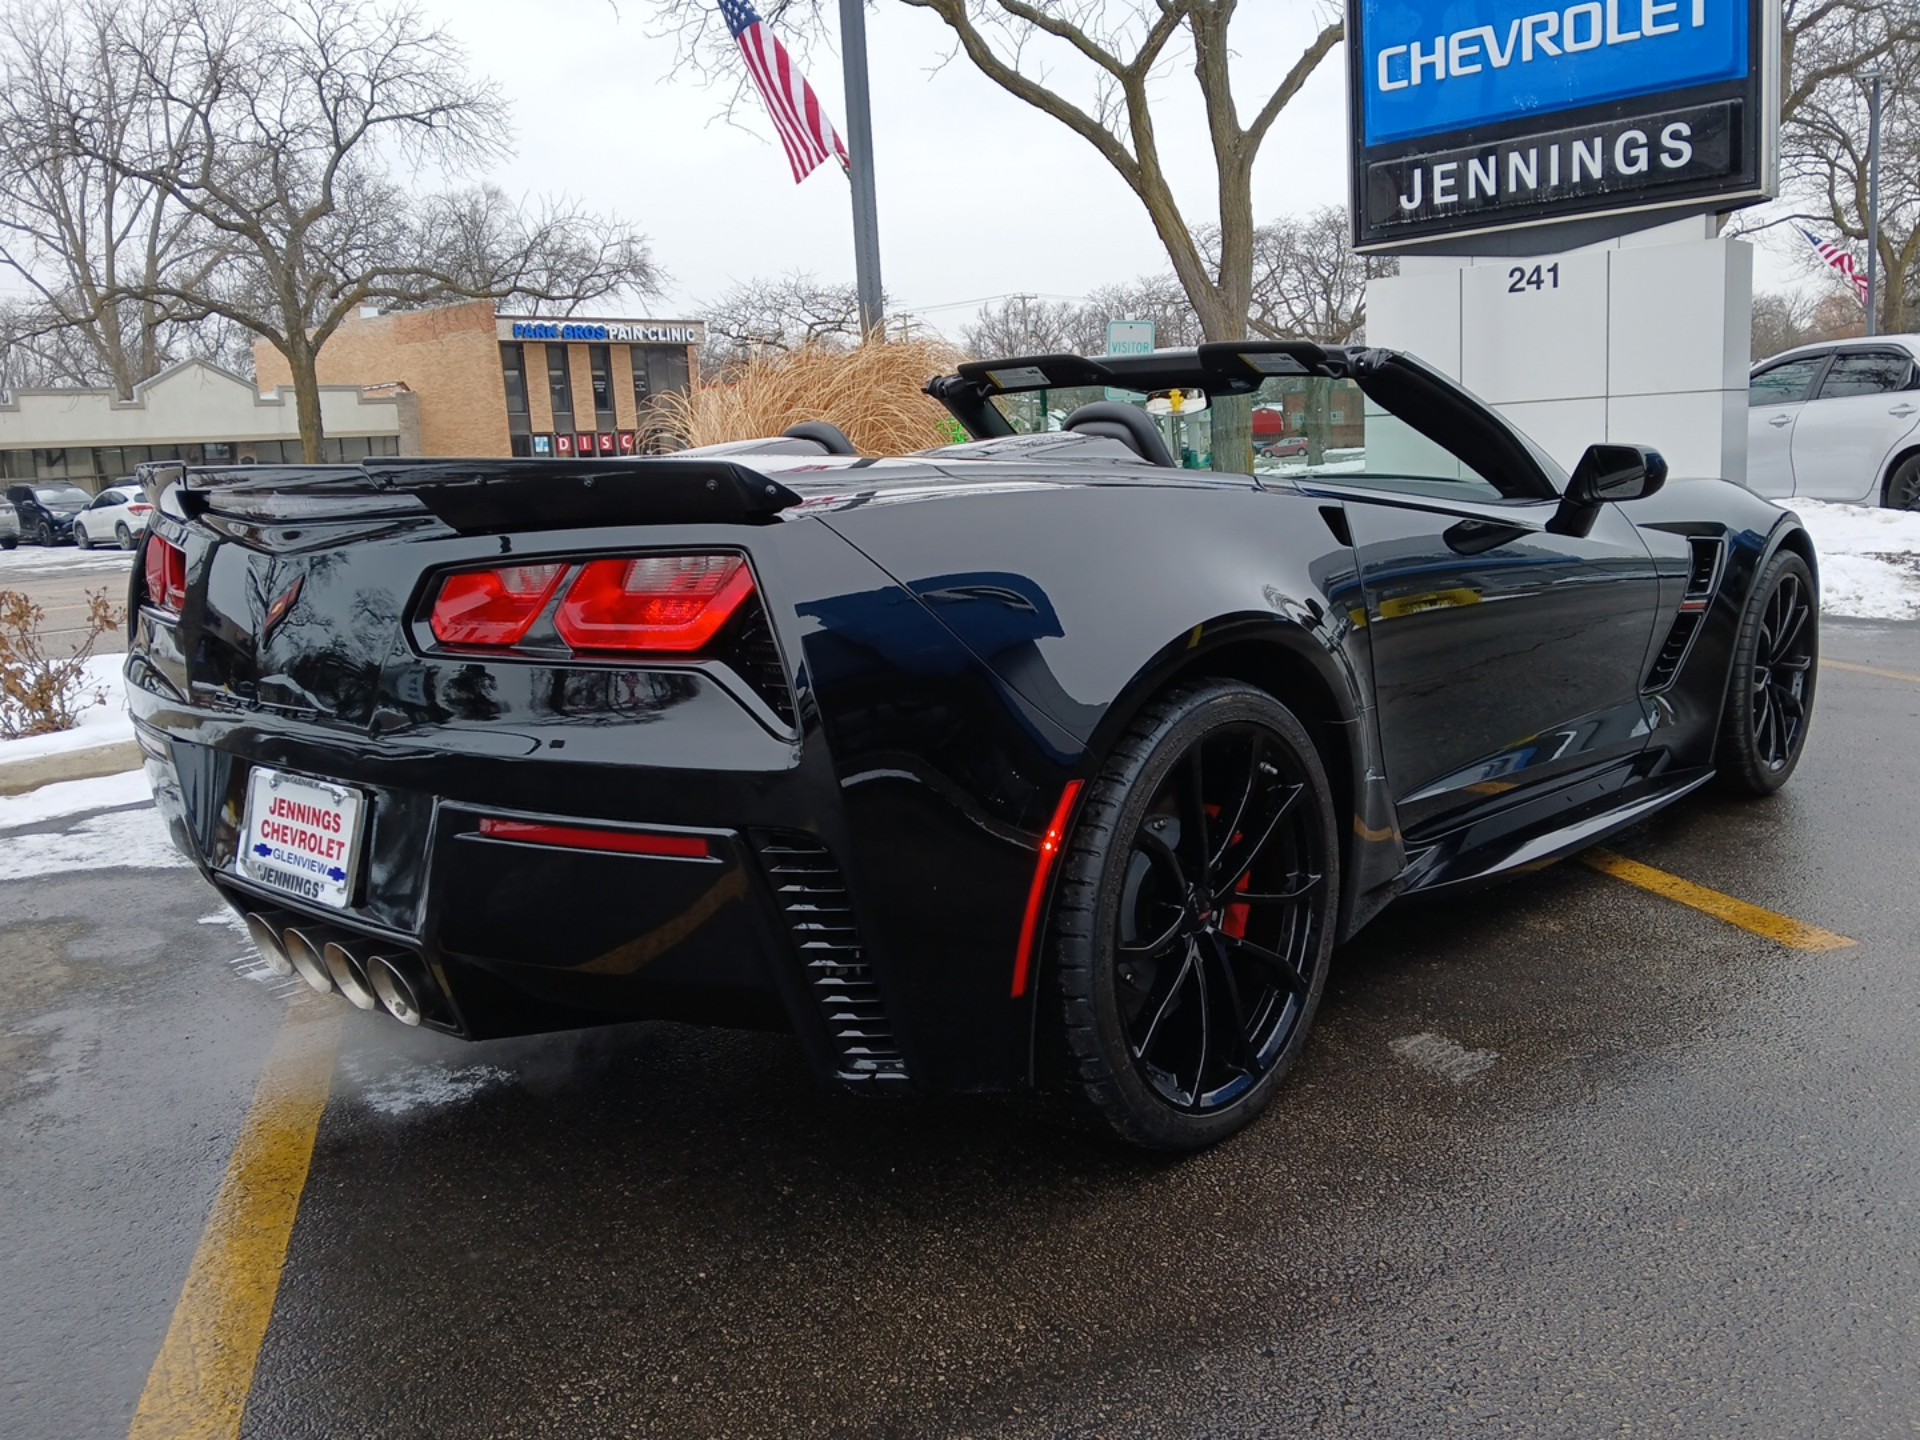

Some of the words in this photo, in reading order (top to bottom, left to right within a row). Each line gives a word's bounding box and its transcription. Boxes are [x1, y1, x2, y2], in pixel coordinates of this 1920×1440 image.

[1400, 122, 1693, 210] JENNINGS
[1508, 263, 1560, 293] 241
[514, 323, 559, 339] PARK
[563, 325, 606, 340] BROS
[608, 326, 644, 341] PAIN
[648, 327, 695, 341] CLINIC
[1111, 342, 1150, 354] VISITOR
[269, 797, 342, 834] JENNINGS
[260, 819, 346, 861] CHEVROLET
[272, 848, 328, 876] GLENVIEW
